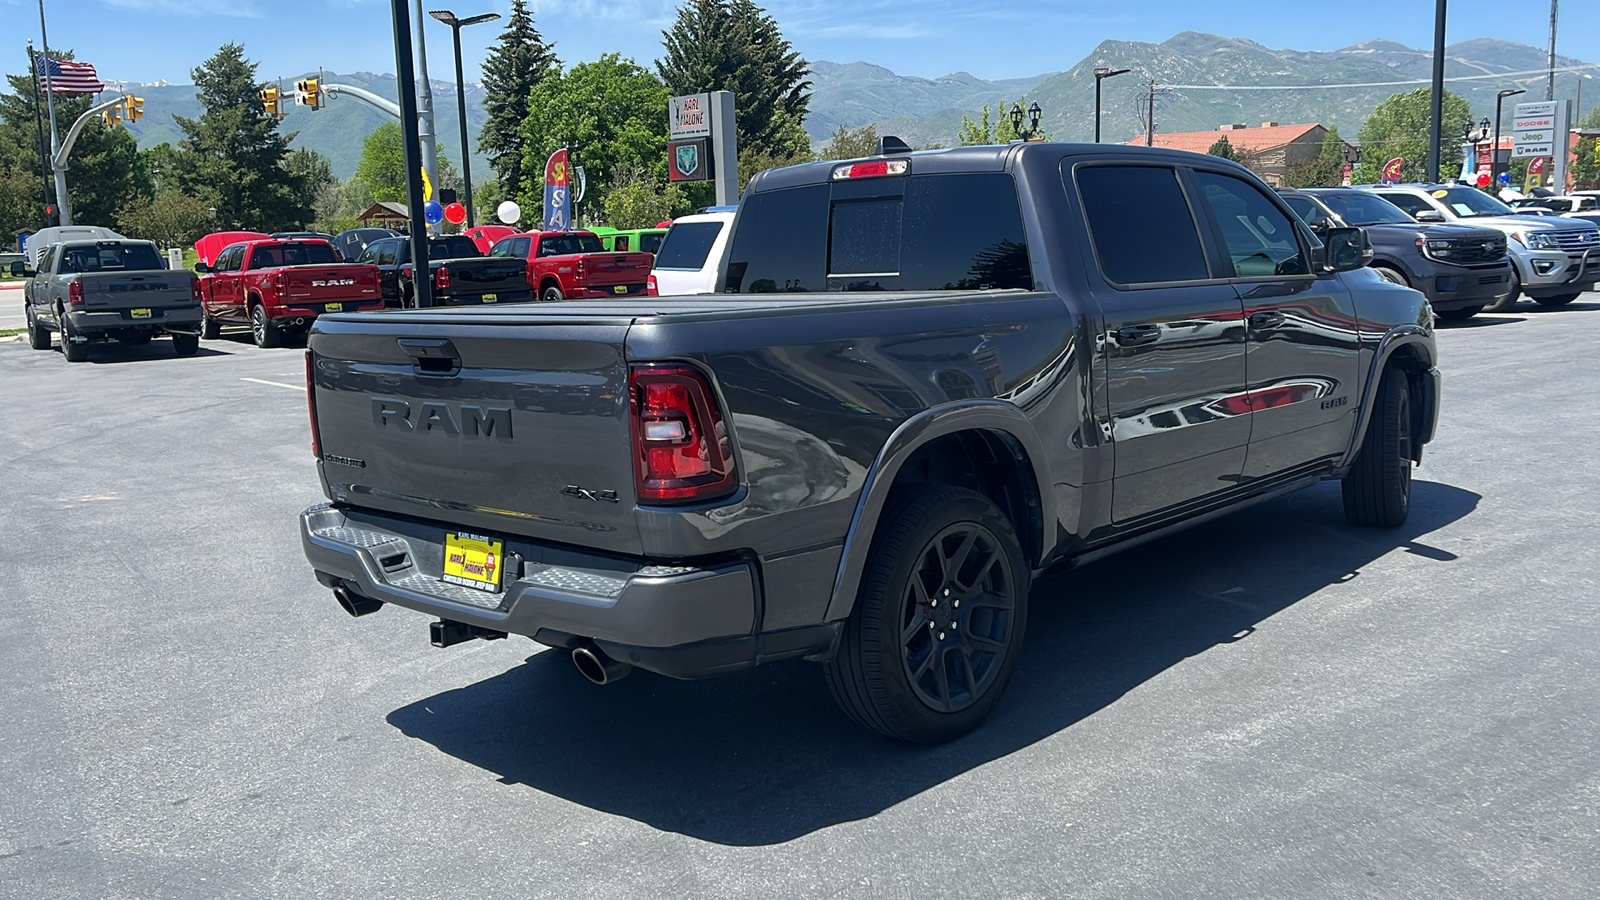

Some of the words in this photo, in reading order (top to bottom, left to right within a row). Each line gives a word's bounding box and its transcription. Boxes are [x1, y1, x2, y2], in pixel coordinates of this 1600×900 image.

[683, 98, 700, 111] KARL
[680, 112, 704, 127] MALONE
[1522, 133, 1543, 141] Jeep
[109, 283, 168, 292] RAM
[311, 279, 354, 287] RAM
[1320, 396, 1348, 410] RAM
[371, 396, 513, 439] RAM
[464, 562, 484, 576] MALONE
